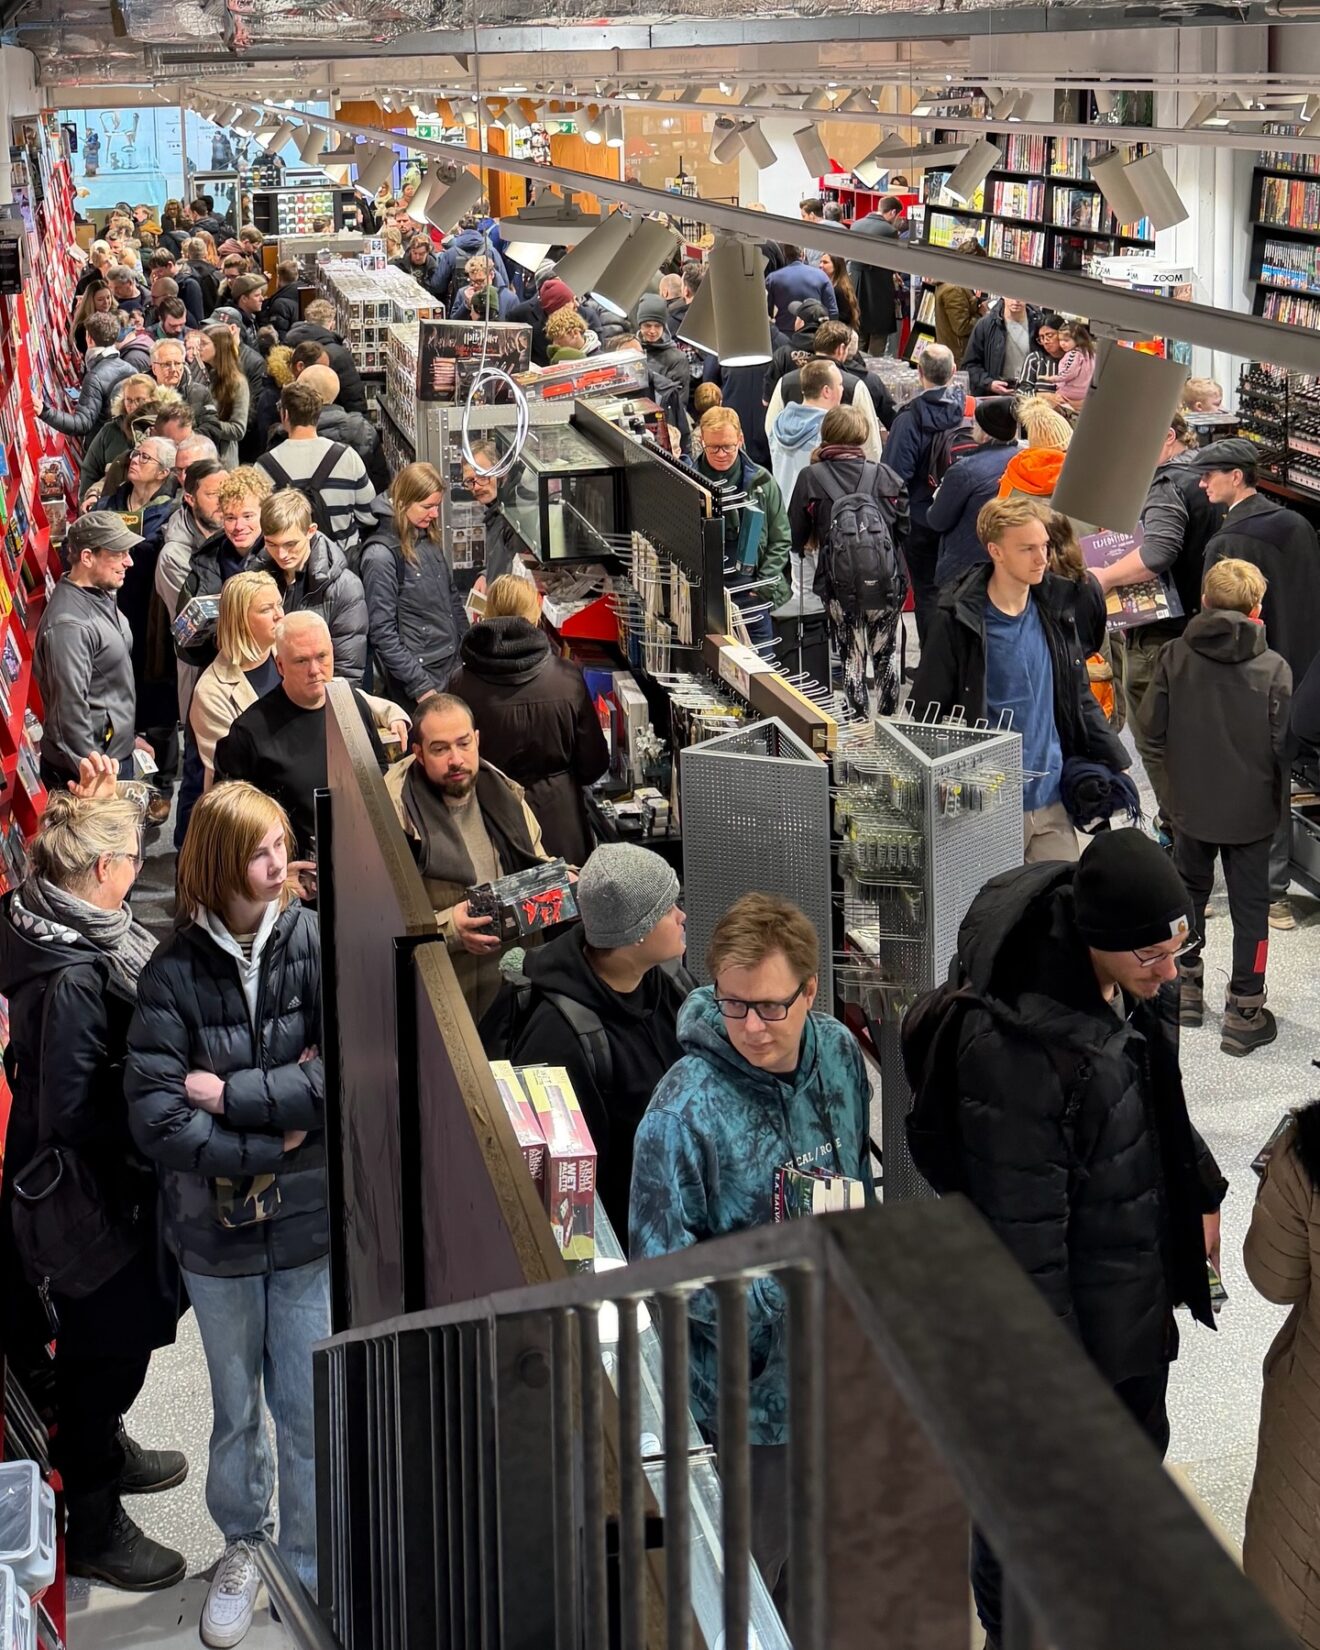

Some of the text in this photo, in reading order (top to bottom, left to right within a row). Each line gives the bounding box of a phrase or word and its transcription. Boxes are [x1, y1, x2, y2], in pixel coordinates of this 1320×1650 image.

[1153, 274, 1183, 282] ZOOM
[819, 1136, 842, 1156] ROE
[567, 1162, 577, 1192] WET
[583, 1159, 594, 1192] ARMY
[773, 1193, 781, 1224] SALVA
